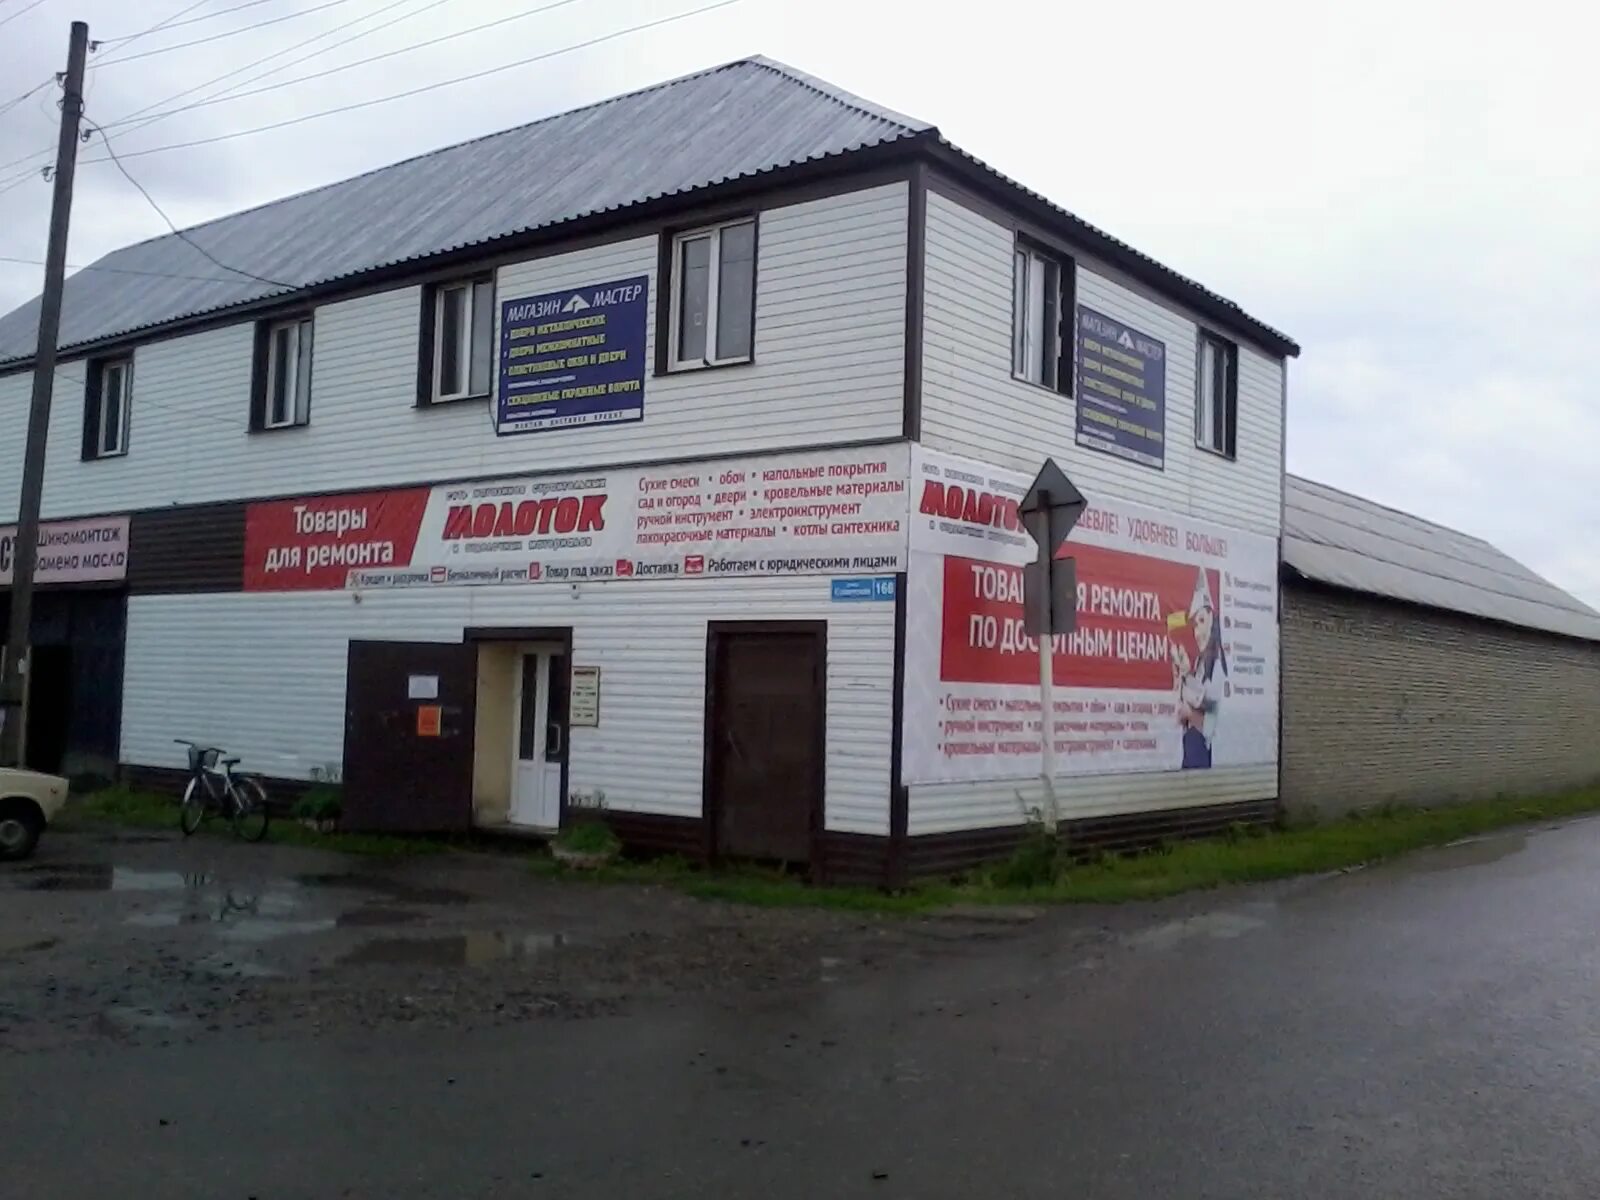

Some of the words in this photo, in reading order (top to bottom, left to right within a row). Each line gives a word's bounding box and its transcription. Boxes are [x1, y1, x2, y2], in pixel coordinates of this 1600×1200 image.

[506, 299, 561, 322] МАГАЗИН
[592, 285, 642, 307] МАСТЕР
[638, 477, 668, 494] Сухие
[670, 477, 700, 490] смеси
[719, 470, 745, 485] обои
[763, 466, 825, 481] напольные
[828, 461, 887, 479] покрытия
[638, 498, 654, 510] сад
[657, 498, 663, 507] и
[665, 495, 701, 510] огород
[714, 491, 746, 506] двери
[764, 485, 833, 503] кровельные
[836, 480, 904, 497] материалы
[919, 479, 1025, 533] МОЛОТО
[293, 505, 368, 538] Товары
[442, 494, 608, 540] МОЛОТОК
[637, 512, 672, 529] ручной
[675, 510, 733, 527] инструмент
[750, 503, 861, 521] электроинструмент
[636, 529, 713, 546] лакокрасочные
[716, 526, 776, 542] материалы
[794, 524, 827, 536] котлы
[831, 520, 900, 534] сантехника
[1127, 517, 1178, 548] УДОБНЕЕ!
[1186, 531, 1228, 558] БОЛЬШЕ!
[264, 548, 301, 573] для
[306, 541, 394, 574] ремонта
[545, 565, 569, 579] Товар
[571, 566, 587, 578] под
[589, 565, 613, 577] заказ
[636, 561, 679, 576] Доставка
[708, 557, 756, 572] Работаем
[759, 559, 764, 570] с
[767, 556, 849, 573] юридическими
[852, 555, 897, 570] лицами
[971, 565, 1024, 604] ТОВА
[1090, 583, 1162, 621] РЕМОНТА
[969, 614, 997, 649] ПО
[1116, 630, 1168, 663] ЦЕНАМ
